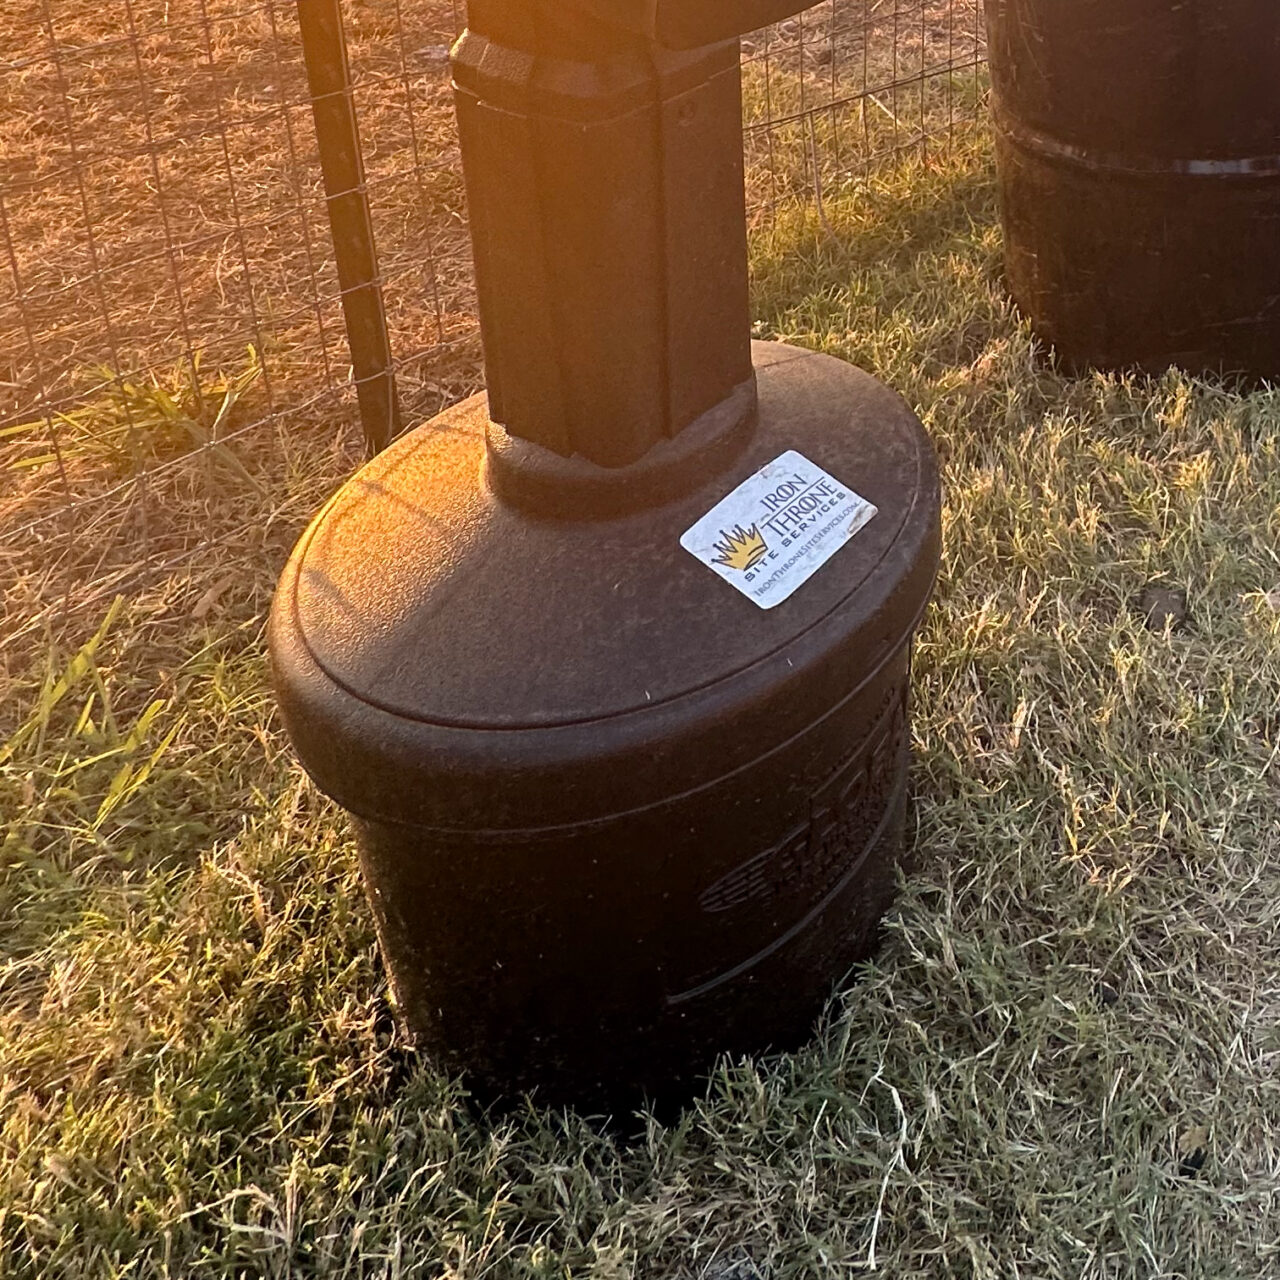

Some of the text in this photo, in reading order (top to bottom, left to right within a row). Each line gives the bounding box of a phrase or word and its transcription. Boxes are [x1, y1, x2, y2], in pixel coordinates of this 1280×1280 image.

[759, 473, 807, 513] IRON
[760, 477, 838, 538] THRONE
[744, 492, 846, 582] SITE SERVICES
